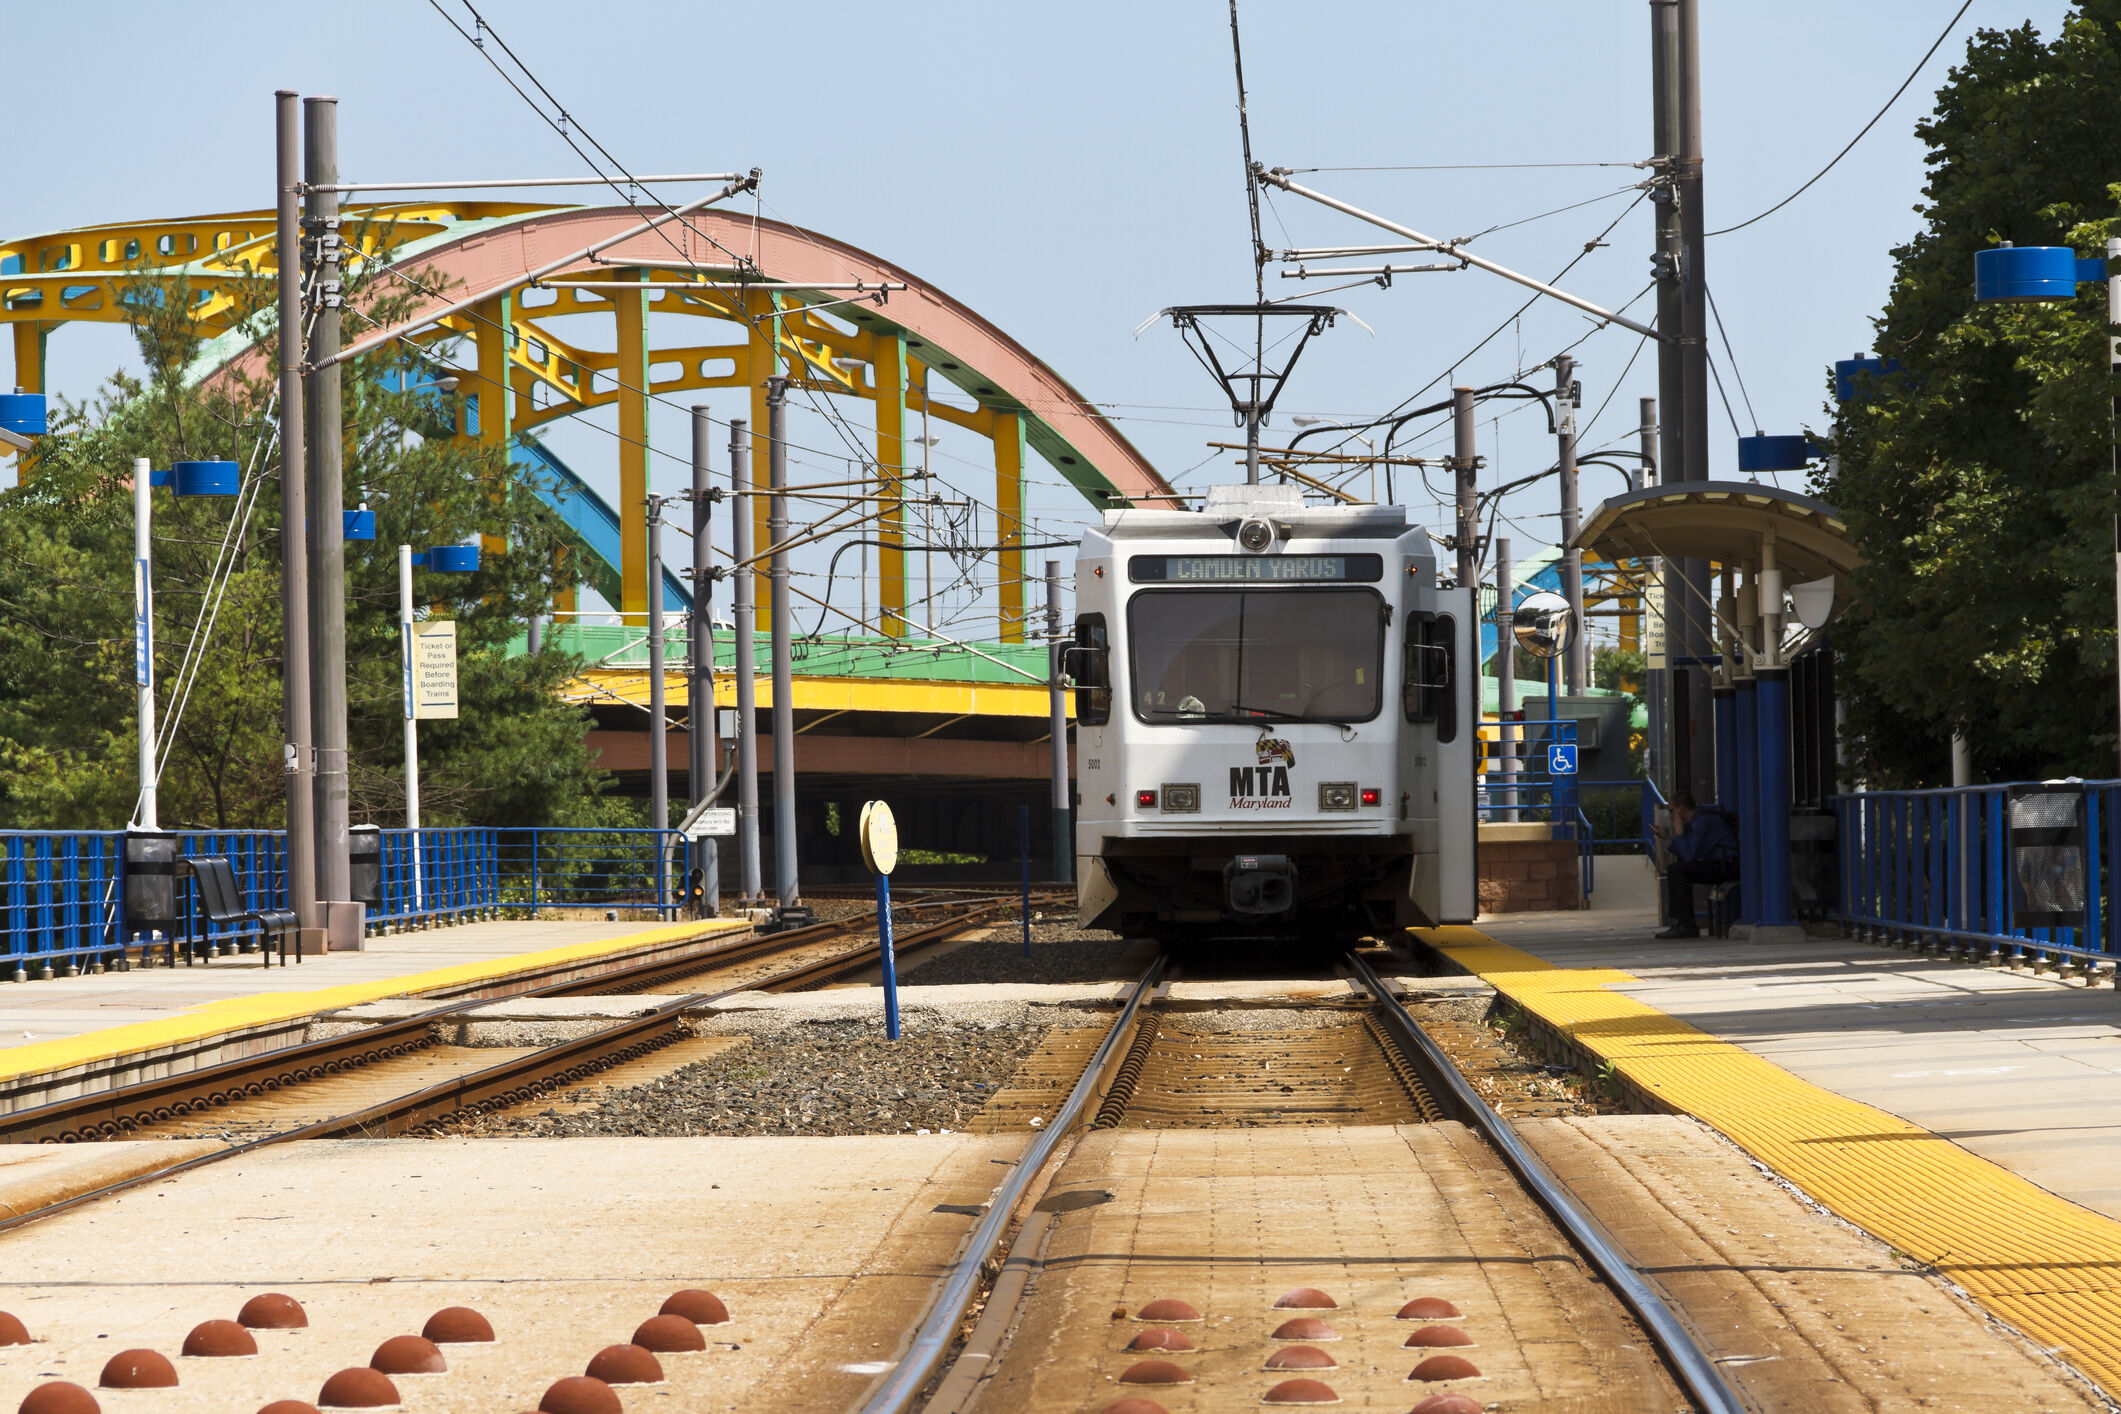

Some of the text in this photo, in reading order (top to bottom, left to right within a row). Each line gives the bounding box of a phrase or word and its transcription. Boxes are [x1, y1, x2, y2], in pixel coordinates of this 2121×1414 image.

[1177, 558, 1336, 578] CAMDEN YARDS
[1230, 766, 1290, 797] MTA
[1229, 797, 1292, 811] Maryland
